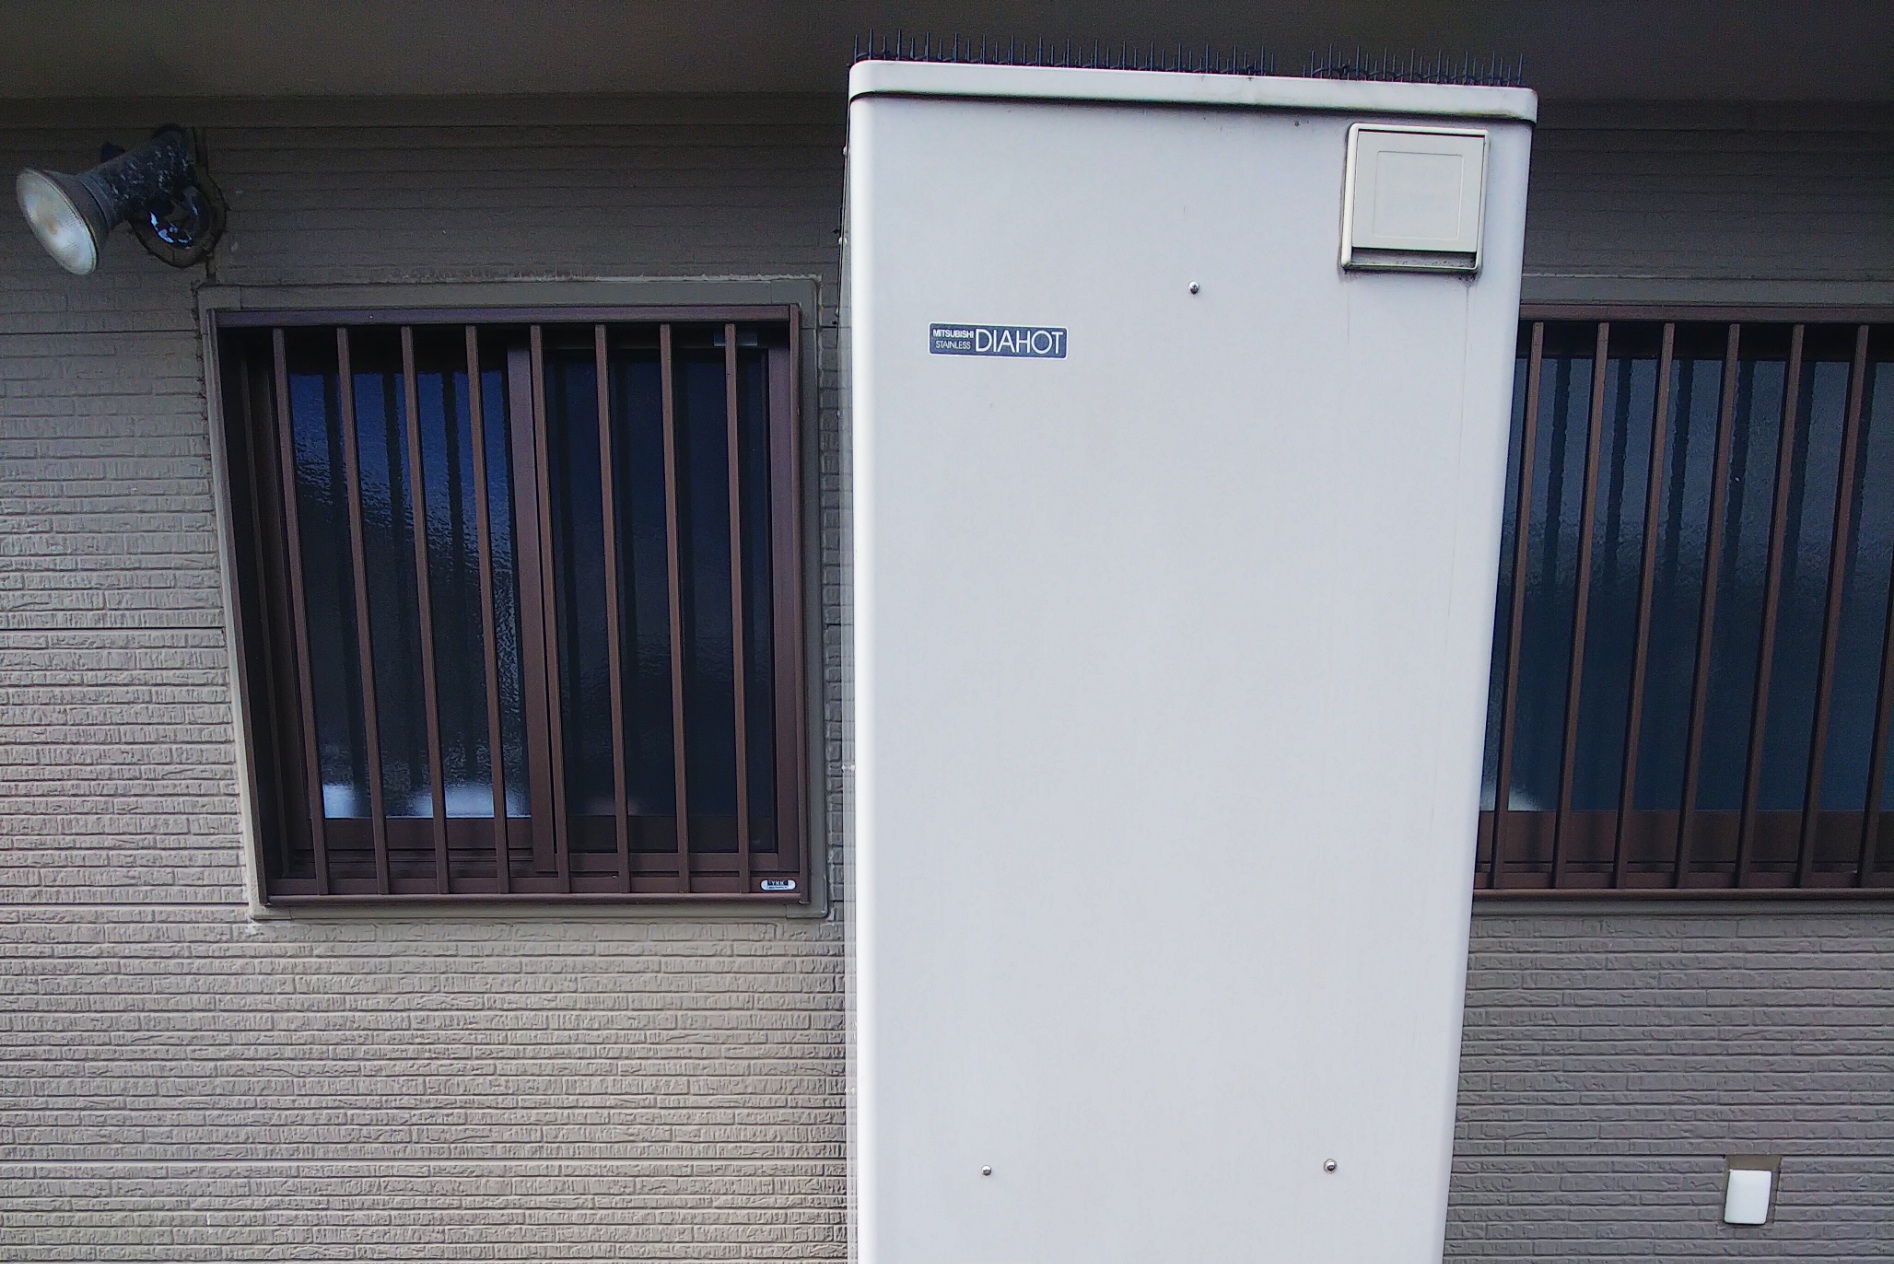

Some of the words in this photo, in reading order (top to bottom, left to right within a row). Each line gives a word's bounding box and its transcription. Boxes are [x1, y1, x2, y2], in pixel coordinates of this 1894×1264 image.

[933, 329, 974, 339] MITSUBISHI
[975, 328, 1064, 354] DIAHOT
[935, 340, 971, 350] STAINLESS
